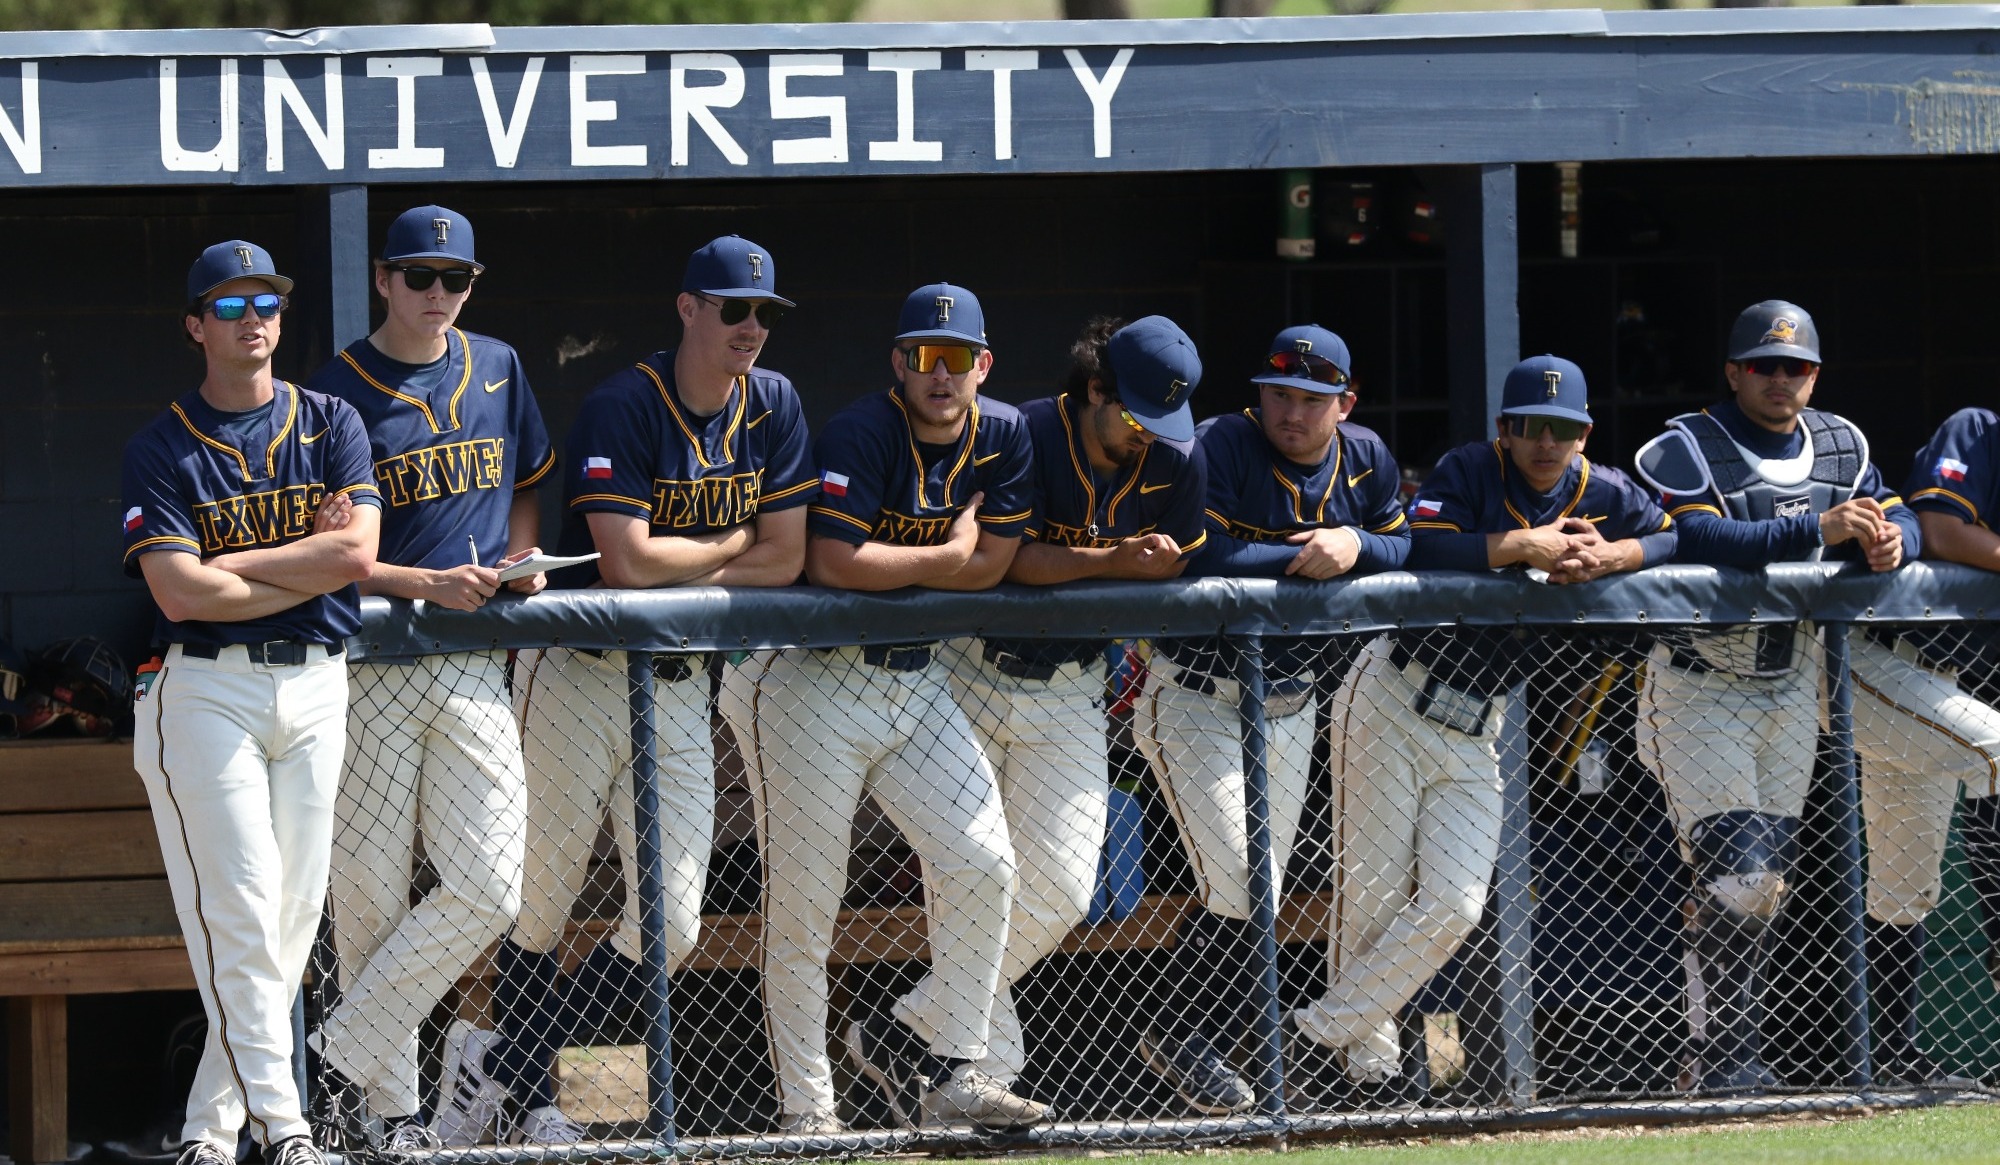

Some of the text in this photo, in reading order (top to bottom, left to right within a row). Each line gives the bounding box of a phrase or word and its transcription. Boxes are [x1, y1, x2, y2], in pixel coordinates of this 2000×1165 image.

[159, 48, 1134, 173] UNIVERSITY
[433, 218, 450, 244] T
[234, 245, 253, 269] T
[748, 253, 763, 280] T
[935, 296, 954, 322] T
[1164, 379, 1188, 402] T
[1544, 370, 1562, 397] T
